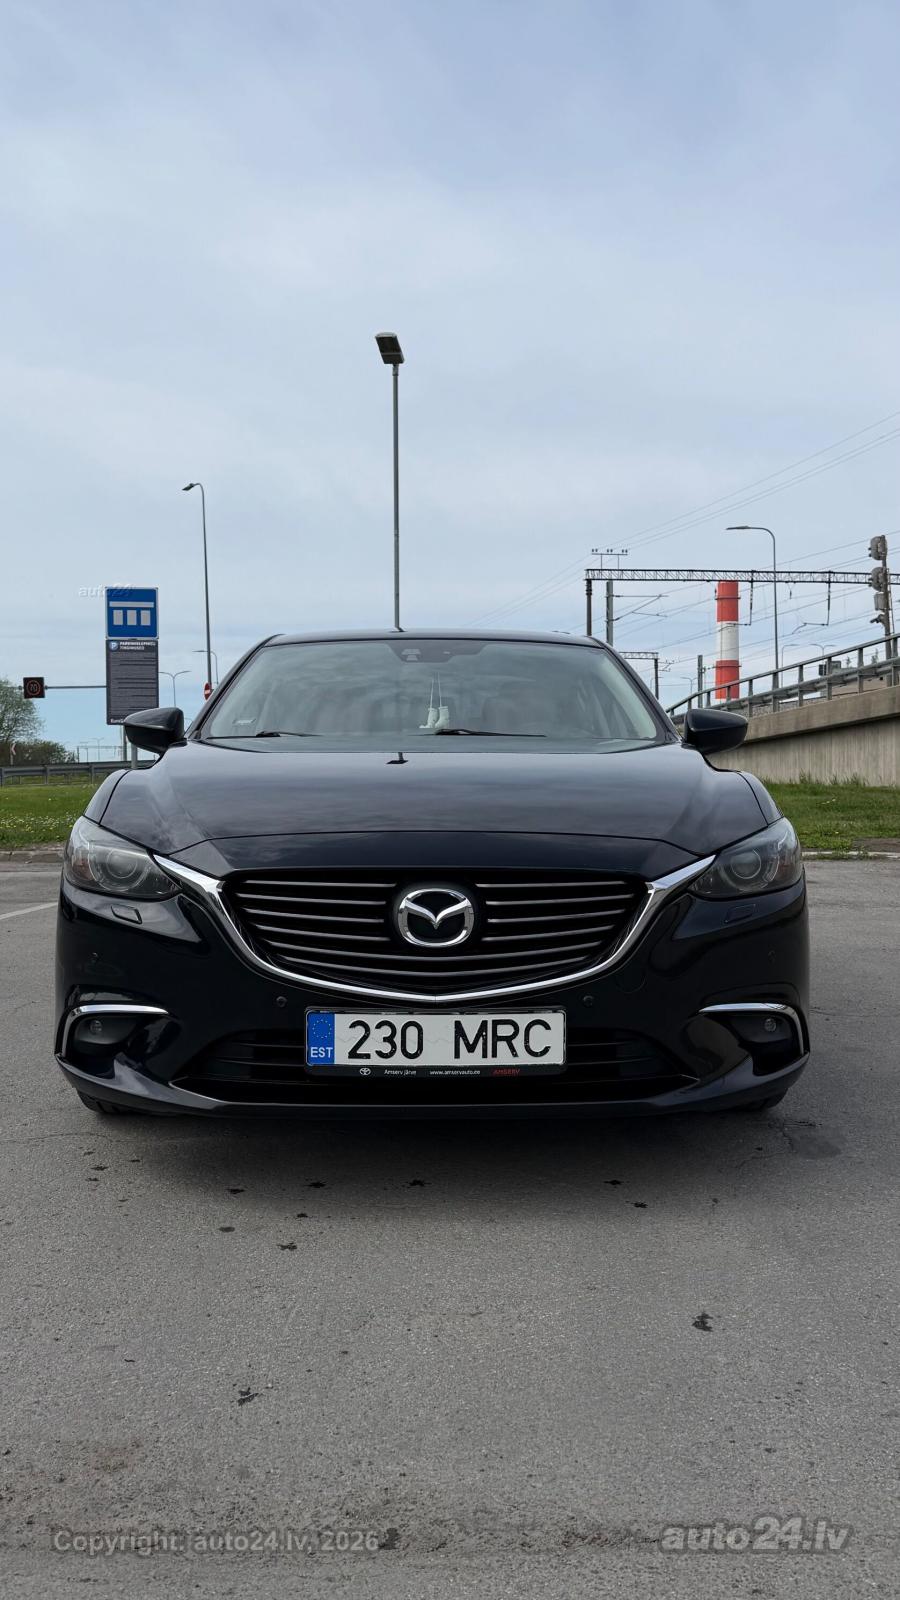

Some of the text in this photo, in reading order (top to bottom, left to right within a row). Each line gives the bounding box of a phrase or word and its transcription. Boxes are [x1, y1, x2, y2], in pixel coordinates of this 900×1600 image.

[348, 1019, 552, 1059] 230 MRC
[310, 1047, 333, 1058] EST
